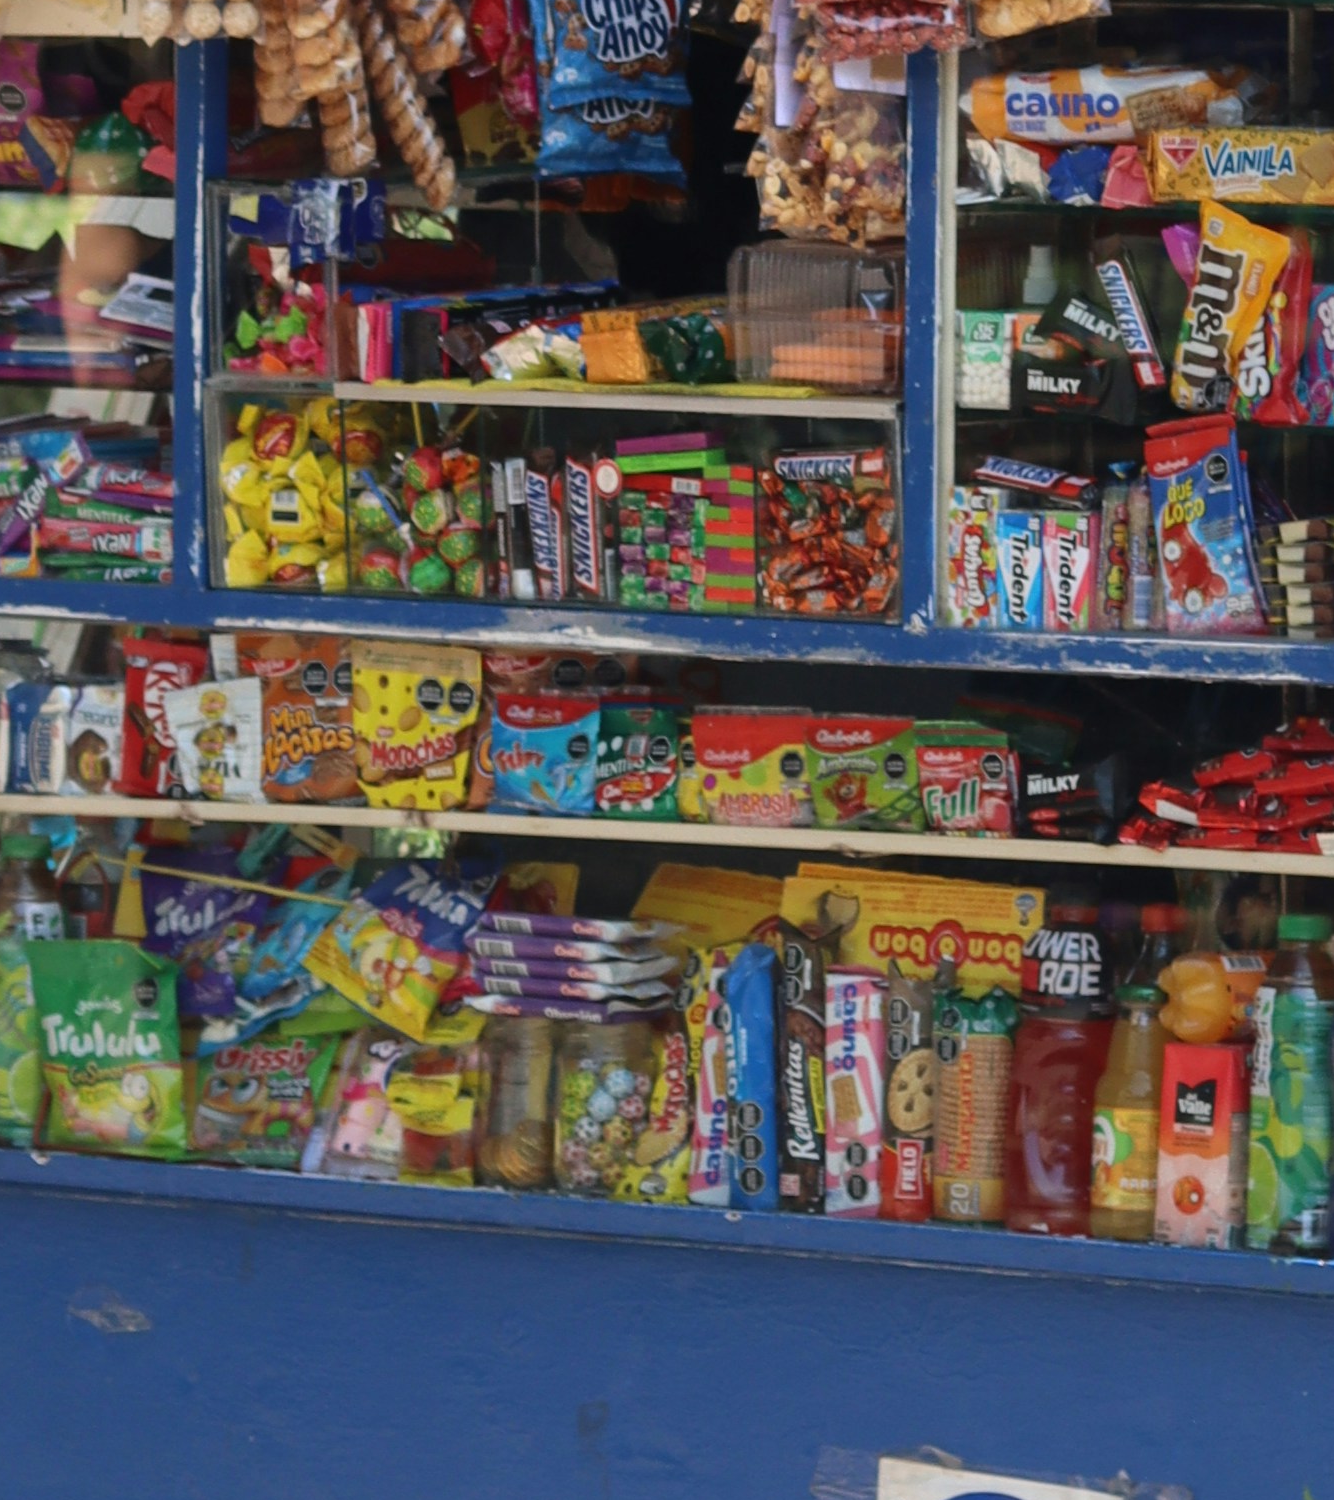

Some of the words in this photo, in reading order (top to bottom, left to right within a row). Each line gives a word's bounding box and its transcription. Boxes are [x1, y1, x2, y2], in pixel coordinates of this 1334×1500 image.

[1005, 91, 1121, 119] casino
[1204, 136, 1295, 179] VAINILLA
[1063, 301, 1122, 343] MILKY
[1098, 262, 1148, 351] SNICKERS
[1027, 374, 1082, 395] MILKY
[778, 458, 853, 480] SNICKERS
[568, 464, 593, 583] SNICKERS
[1164, 498, 1206, 529] LOCO
[1011, 532, 1030, 623] Trident
[1058, 531, 1078, 623] Trident
[270, 706, 315, 734] Mini
[371, 734, 457, 769] Morochas
[923, 777, 979, 826] Full
[1027, 774, 1080, 796] MILKY
[1024, 930, 1103, 963] OWER
[41, 1012, 162, 1059] Trululu
[842, 983, 857, 1071] casino
[786, 1040, 820, 1161] Rellenitas
[1178, 1098, 1213, 1116] Valle
[704, 1098, 728, 1187] casino
[901, 1145, 918, 1193] FIELD
[949, 1182, 969, 1215] 20
